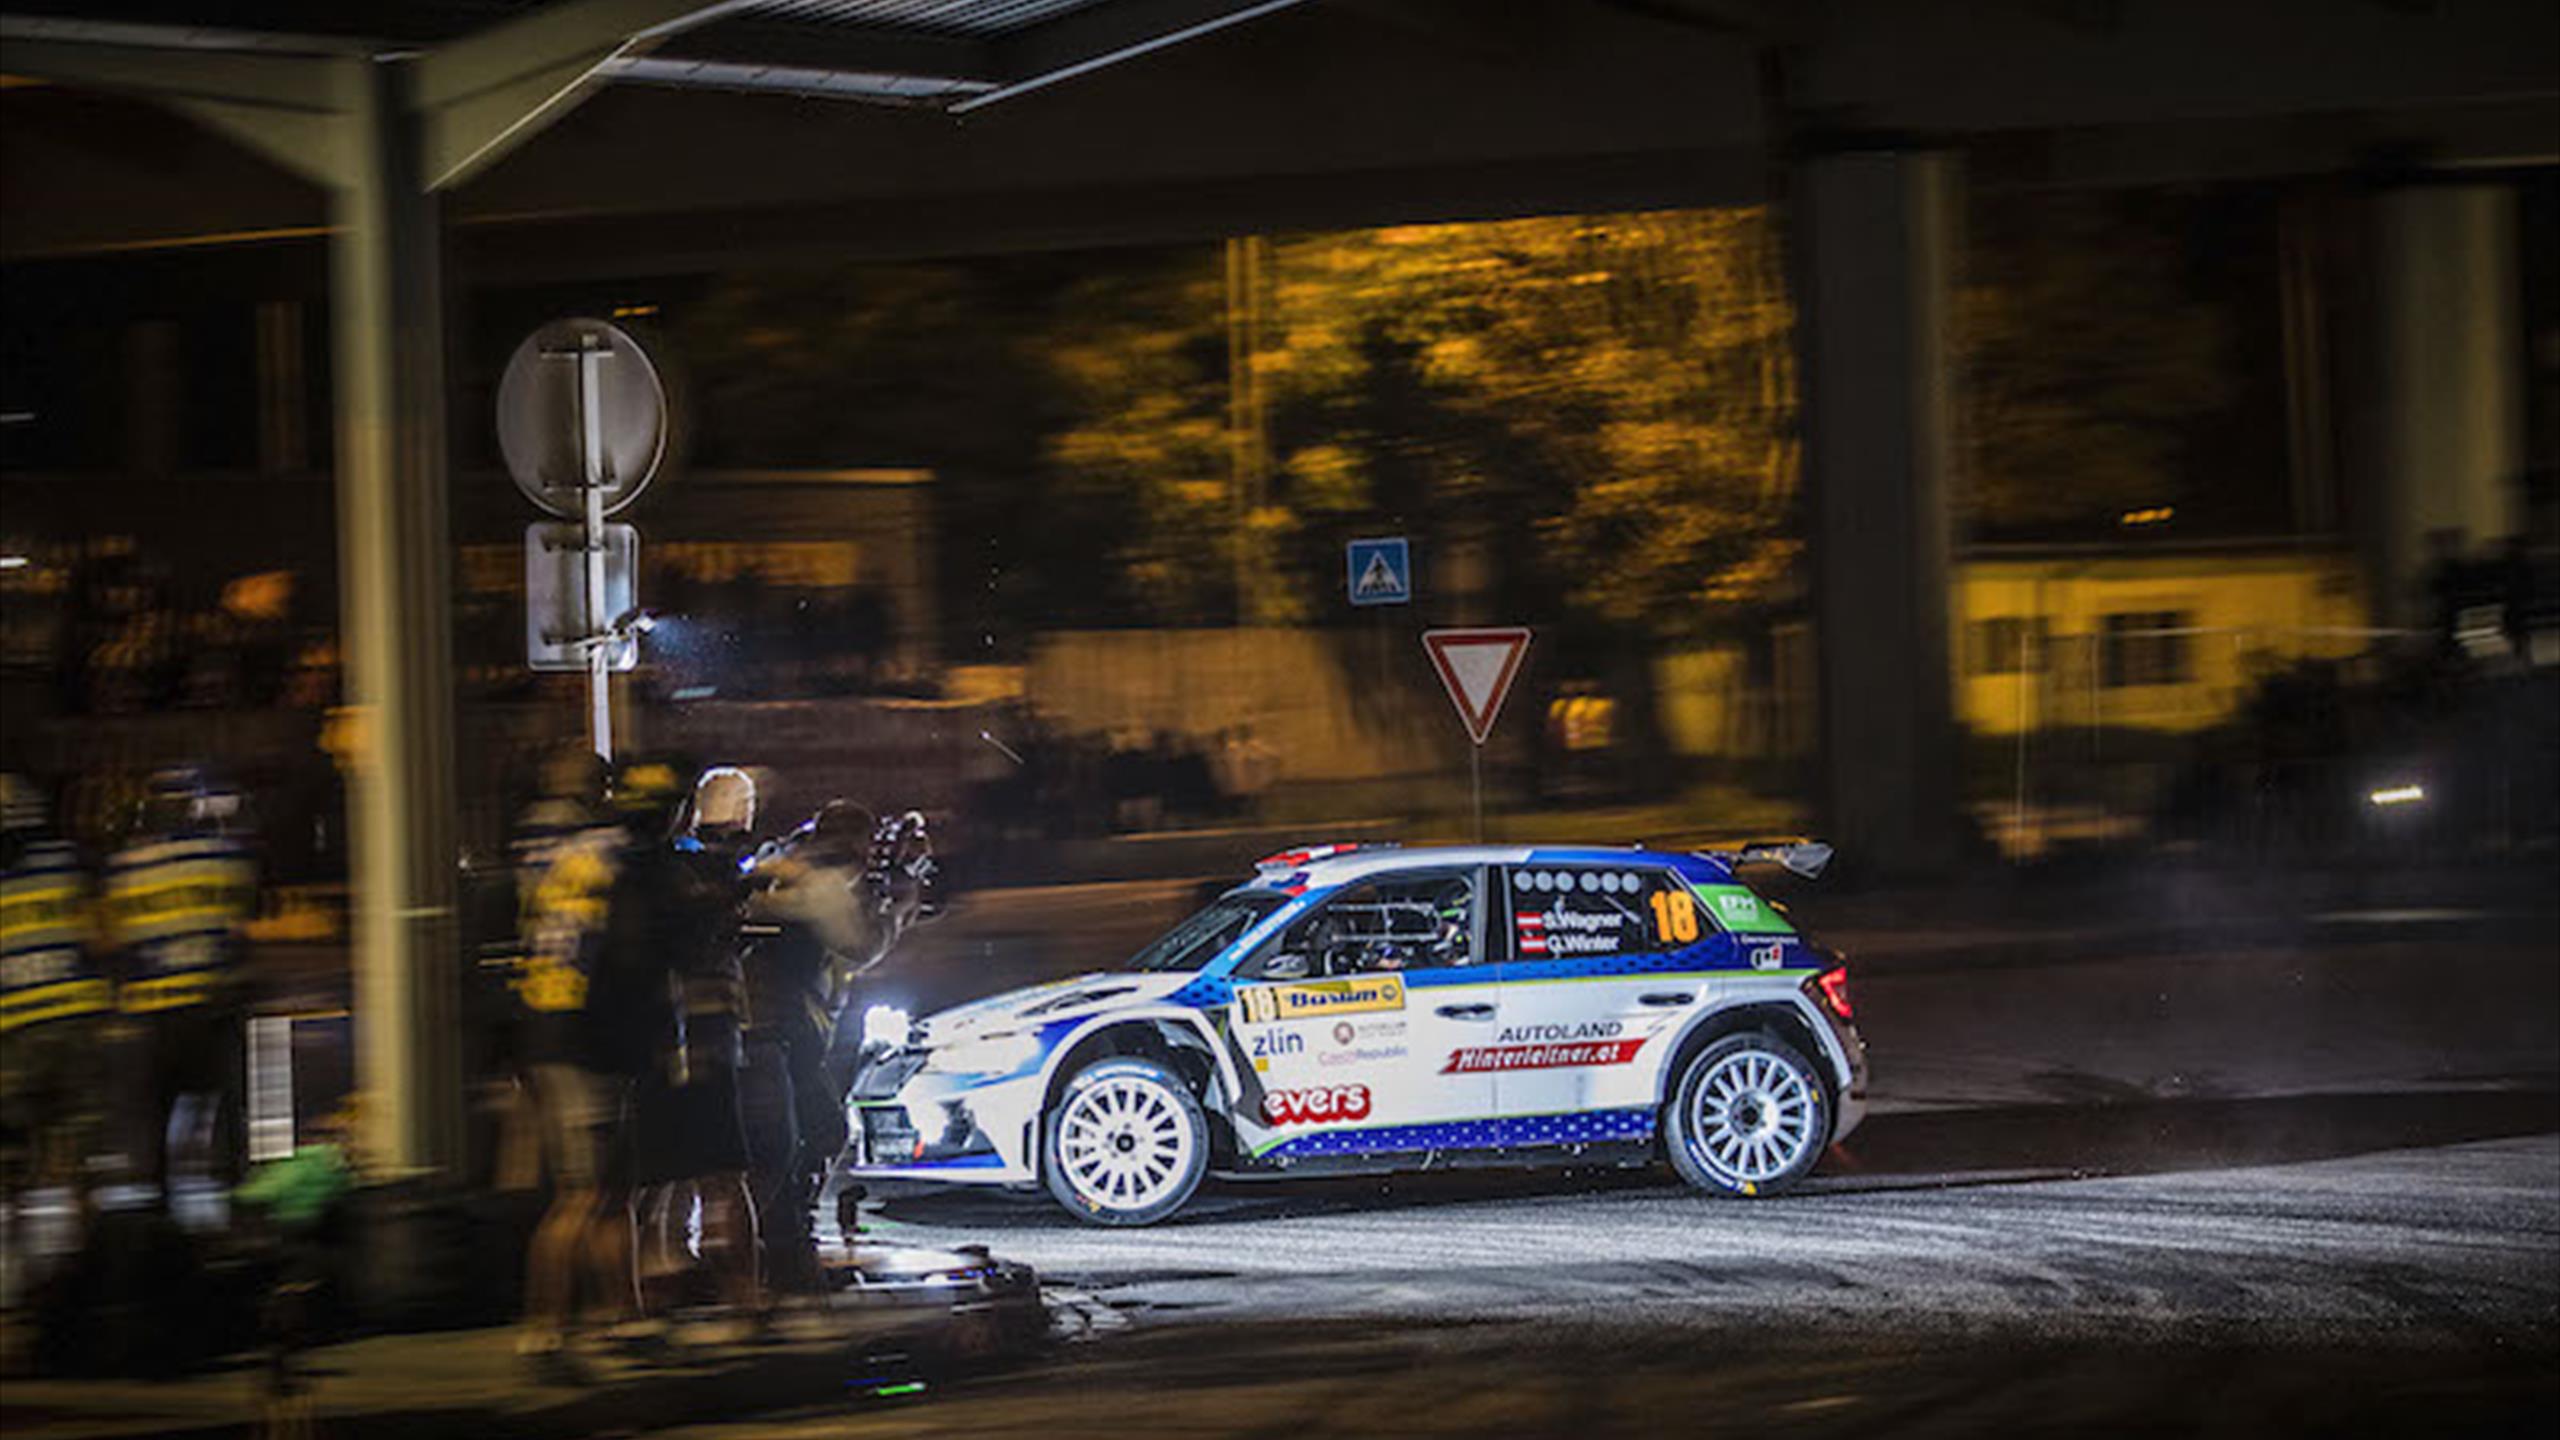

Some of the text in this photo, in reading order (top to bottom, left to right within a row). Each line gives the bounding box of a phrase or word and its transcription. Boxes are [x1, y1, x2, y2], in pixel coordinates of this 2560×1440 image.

[1650, 890, 1699, 943] 18
[1244, 988, 1277, 1022] 18
[1498, 1021, 1623, 1043] AUTOLAND
[1264, 1083, 1366, 1118] evers
